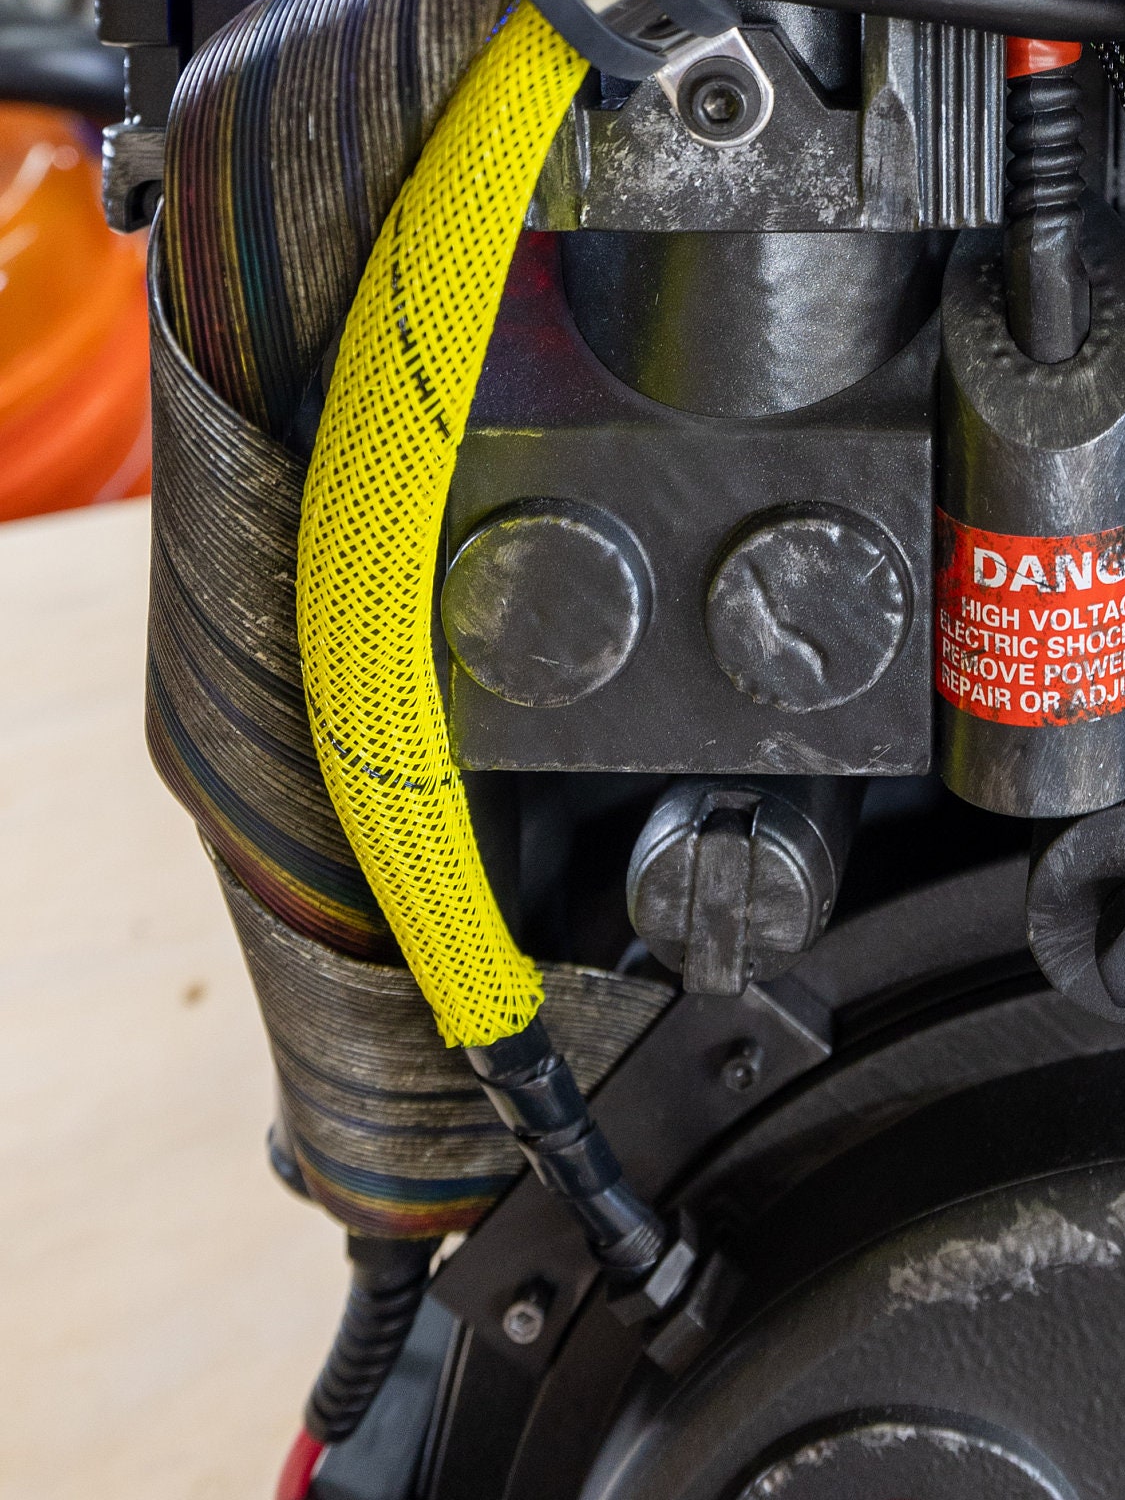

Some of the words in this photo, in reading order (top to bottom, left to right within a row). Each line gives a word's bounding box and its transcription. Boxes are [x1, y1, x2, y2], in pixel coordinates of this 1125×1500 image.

[940, 608, 1038, 659] ELECTRIC
[961, 596, 1020, 631] HIGH
[942, 636, 1035, 686] REMOVE
[940, 661, 1012, 711] REPAIR
[1020, 690, 1060, 714] OR
